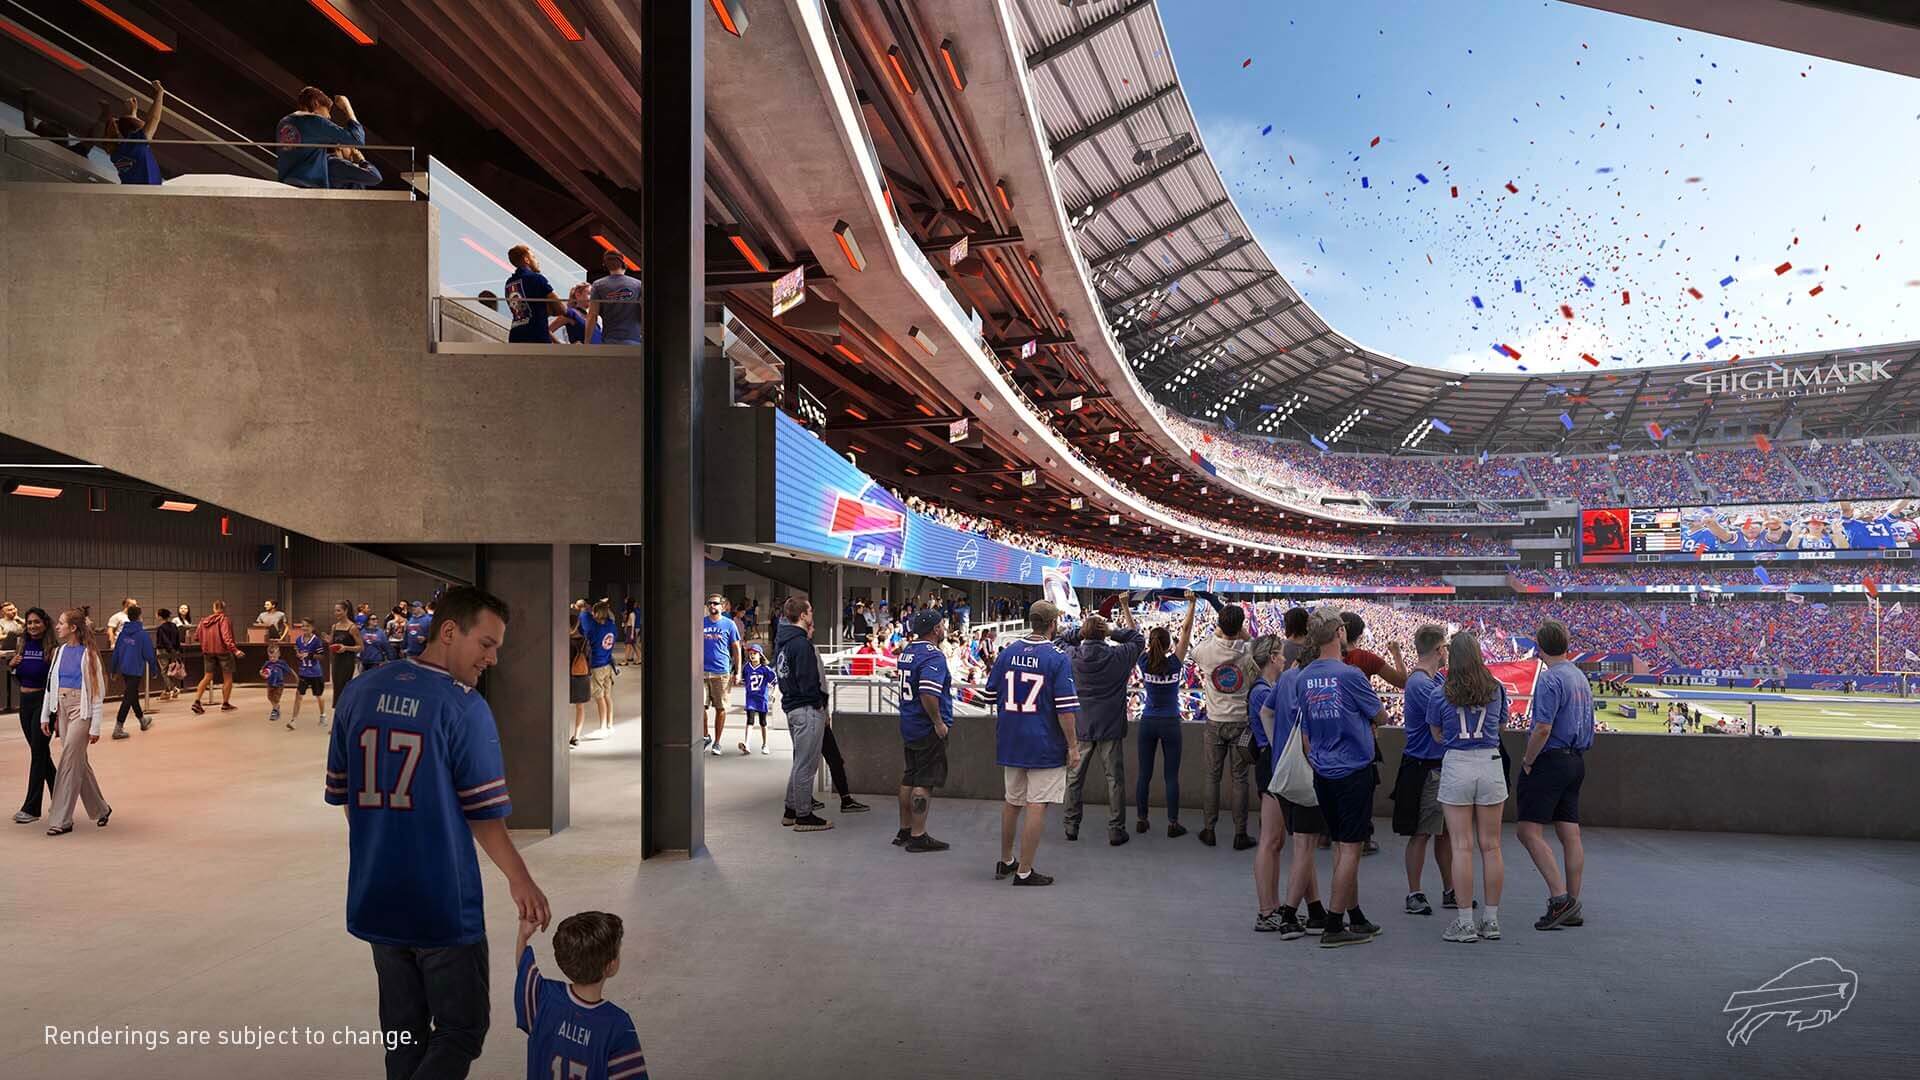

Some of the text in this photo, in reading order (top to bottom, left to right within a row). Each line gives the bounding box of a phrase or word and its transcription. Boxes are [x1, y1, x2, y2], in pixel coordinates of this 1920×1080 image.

[1684, 358, 1893, 395] HIGHMARK
[1740, 385, 1847, 401] STADIUM
[1010, 655, 1039, 669] ALLEN
[749, 674, 764, 691] 27
[1143, 672, 1179, 684] BILLS
[1306, 677, 1338, 689] BILLS
[1004, 670, 1045, 713] 17
[376, 694, 420, 718] ALLEN
[1311, 709, 1340, 720] MAFIA
[1456, 704, 1488, 740] 17
[356, 725, 424, 812] 17
[558, 1020, 592, 1047] ALLEN
